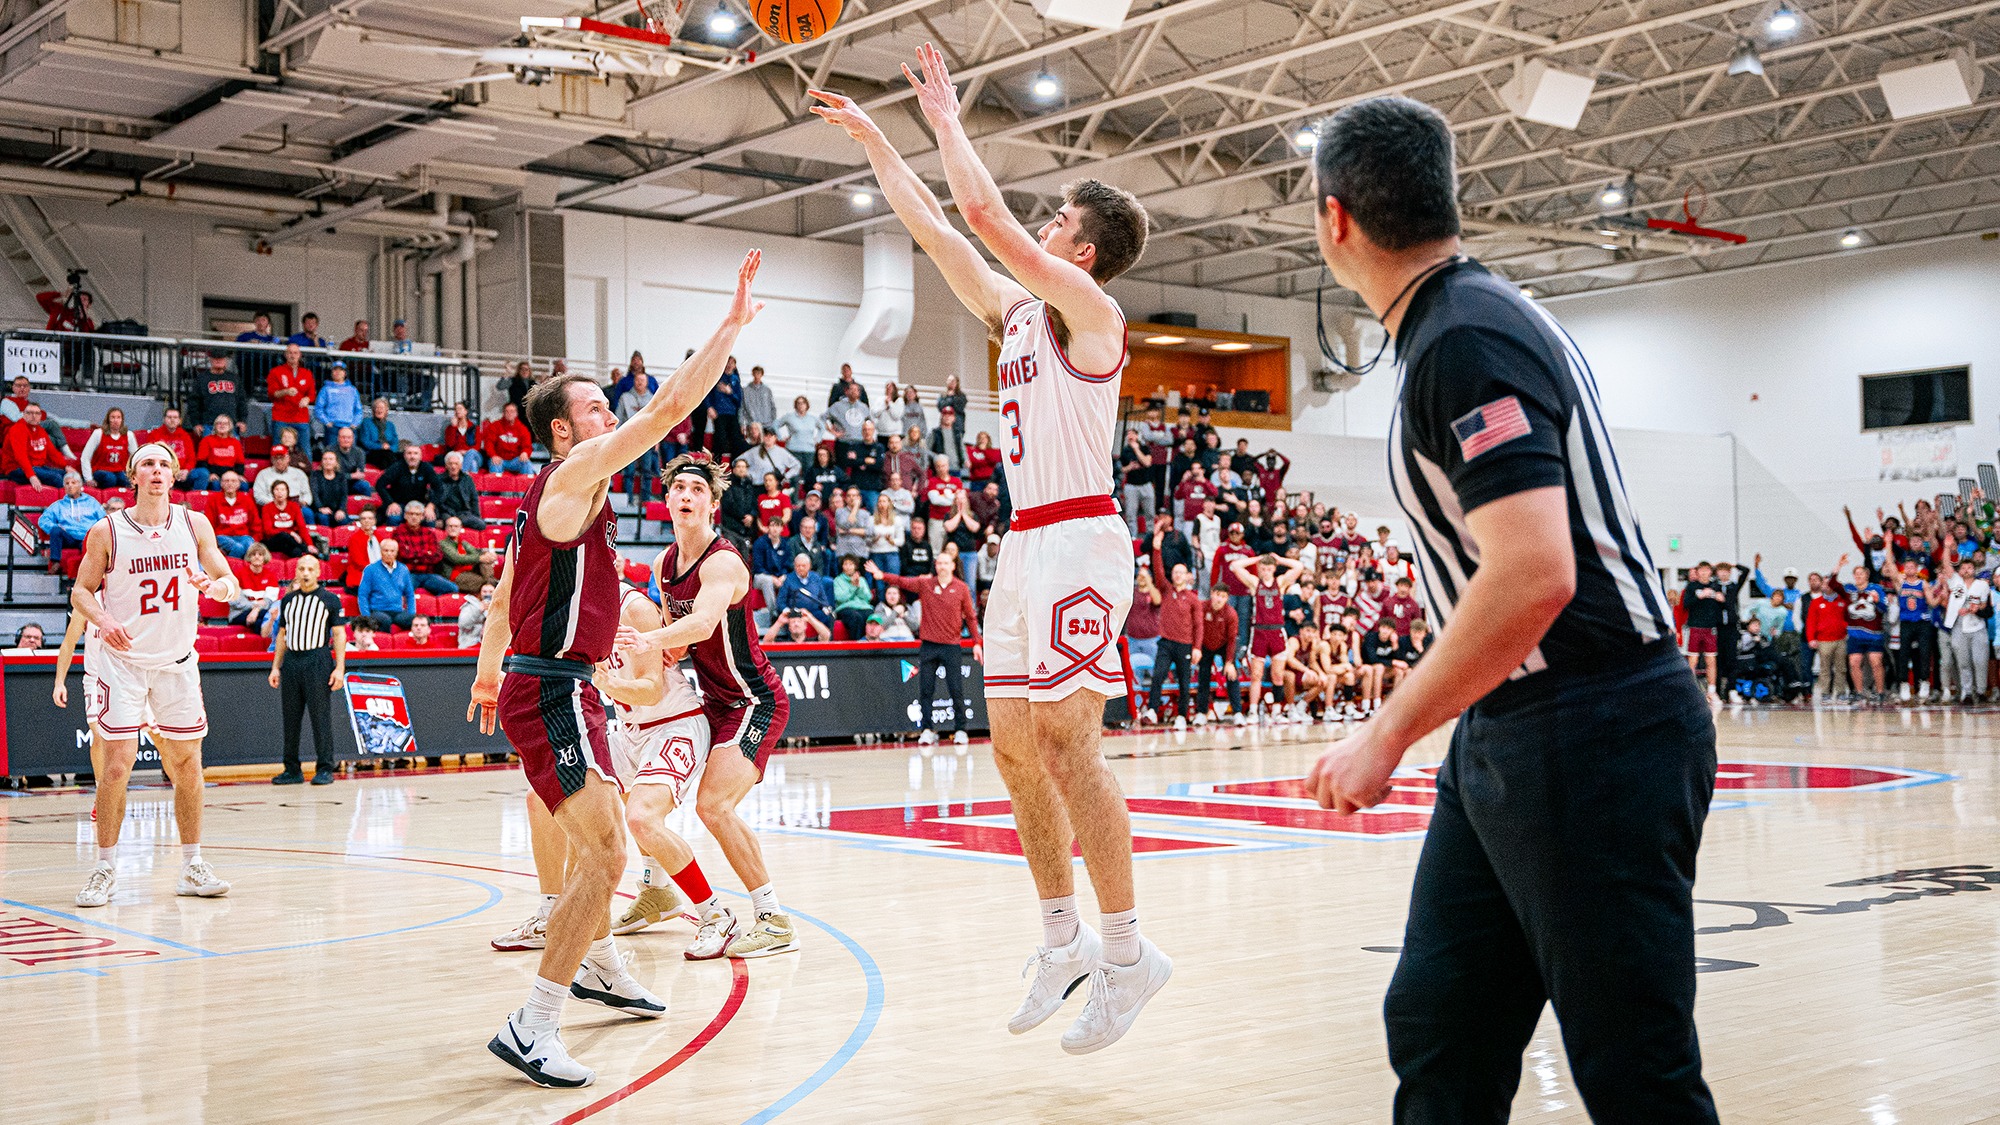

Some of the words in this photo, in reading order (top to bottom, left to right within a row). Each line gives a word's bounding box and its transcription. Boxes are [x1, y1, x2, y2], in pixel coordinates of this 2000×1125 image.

[7, 346, 59, 359] SECTION
[21, 361, 47, 374] 103
[1001, 399, 1025, 466] 3
[128, 553, 189, 575] JOHNNIES
[139, 576, 181, 616] 24
[782, 664, 830, 699] AY!
